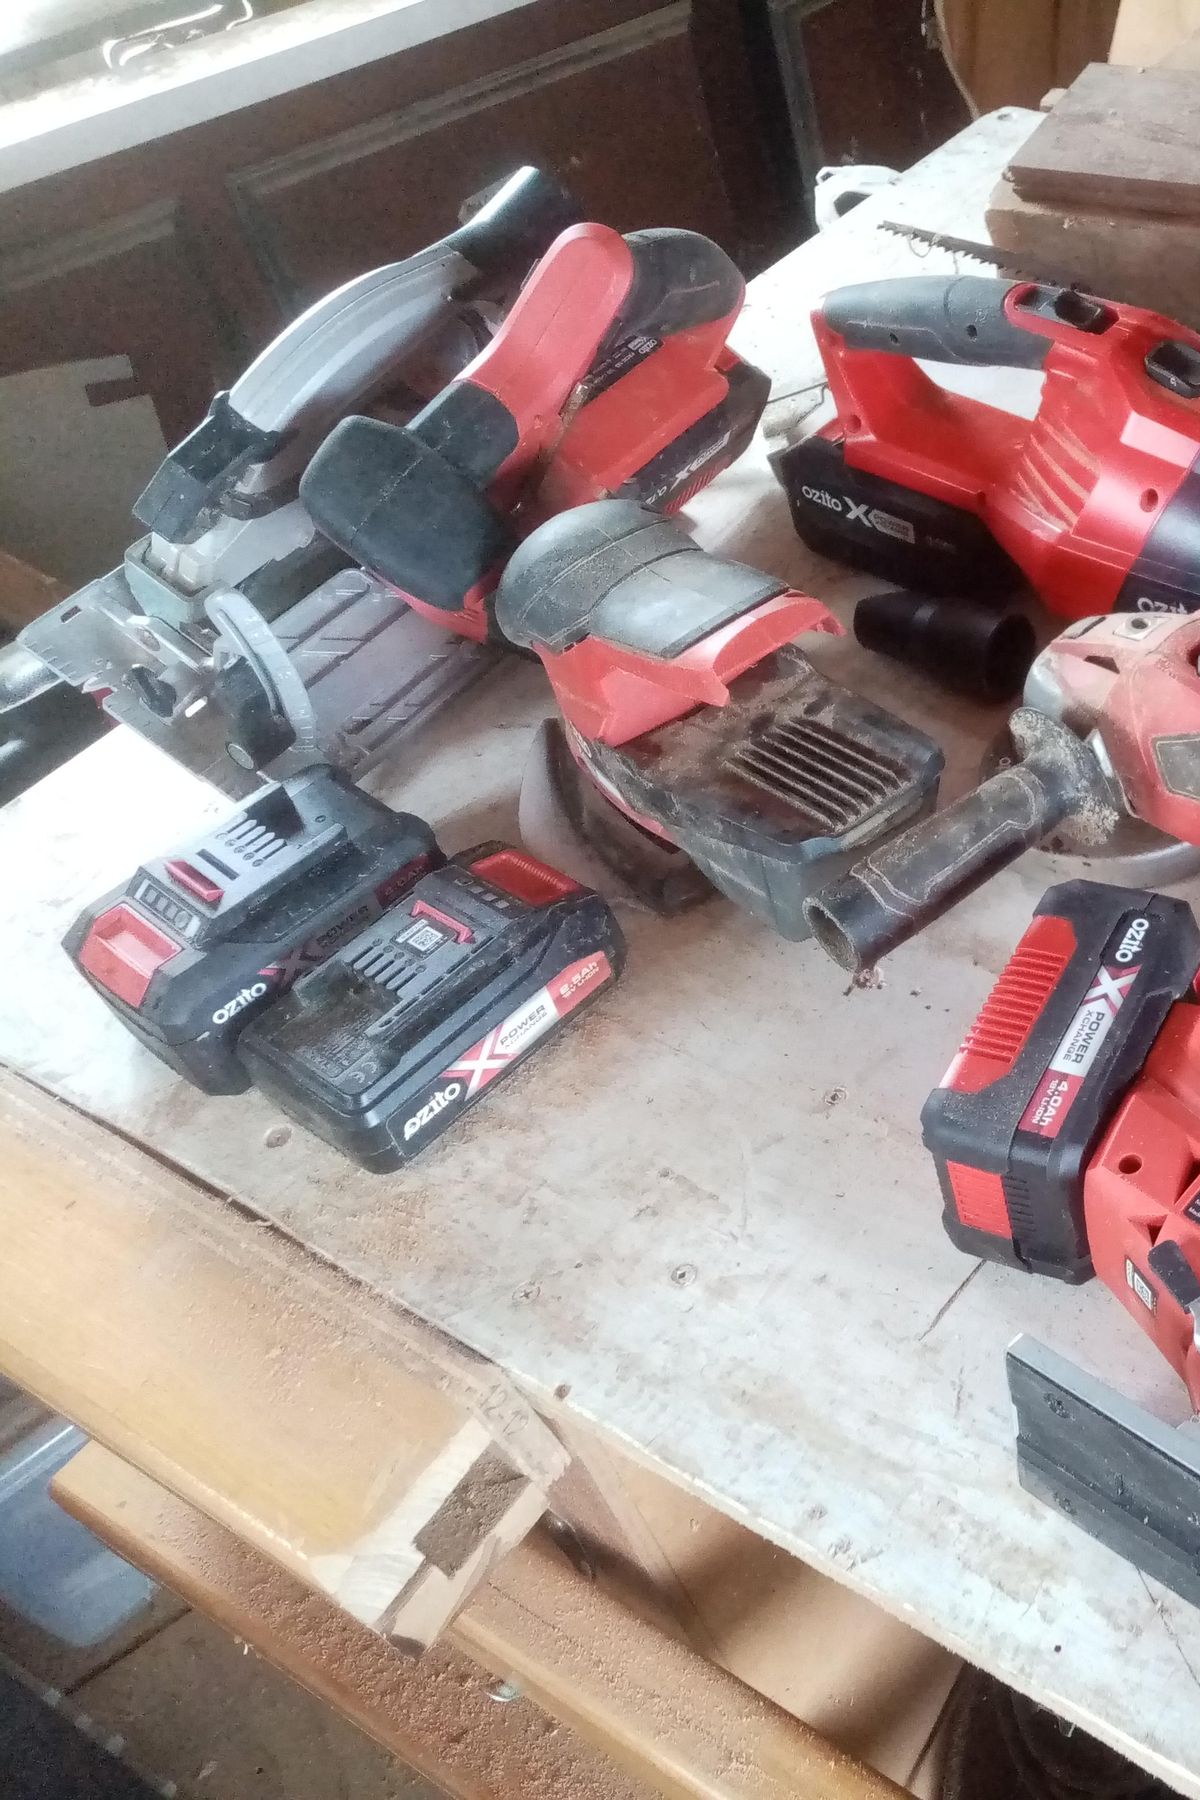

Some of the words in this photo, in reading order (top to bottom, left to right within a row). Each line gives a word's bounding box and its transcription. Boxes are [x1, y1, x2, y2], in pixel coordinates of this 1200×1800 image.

[801, 485, 842, 511] ozito
[1115, 918, 1150, 963] ozito
[212, 982, 267, 1025] ozito
[500, 1004, 547, 1047] POWER
[1062, 1009, 1093, 1061] XCHANGE
[1071, 1010, 1105, 1065] POWER
[403, 1082, 461, 1141] ozito
[1039, 1081, 1069, 1127] 4.0Ah
